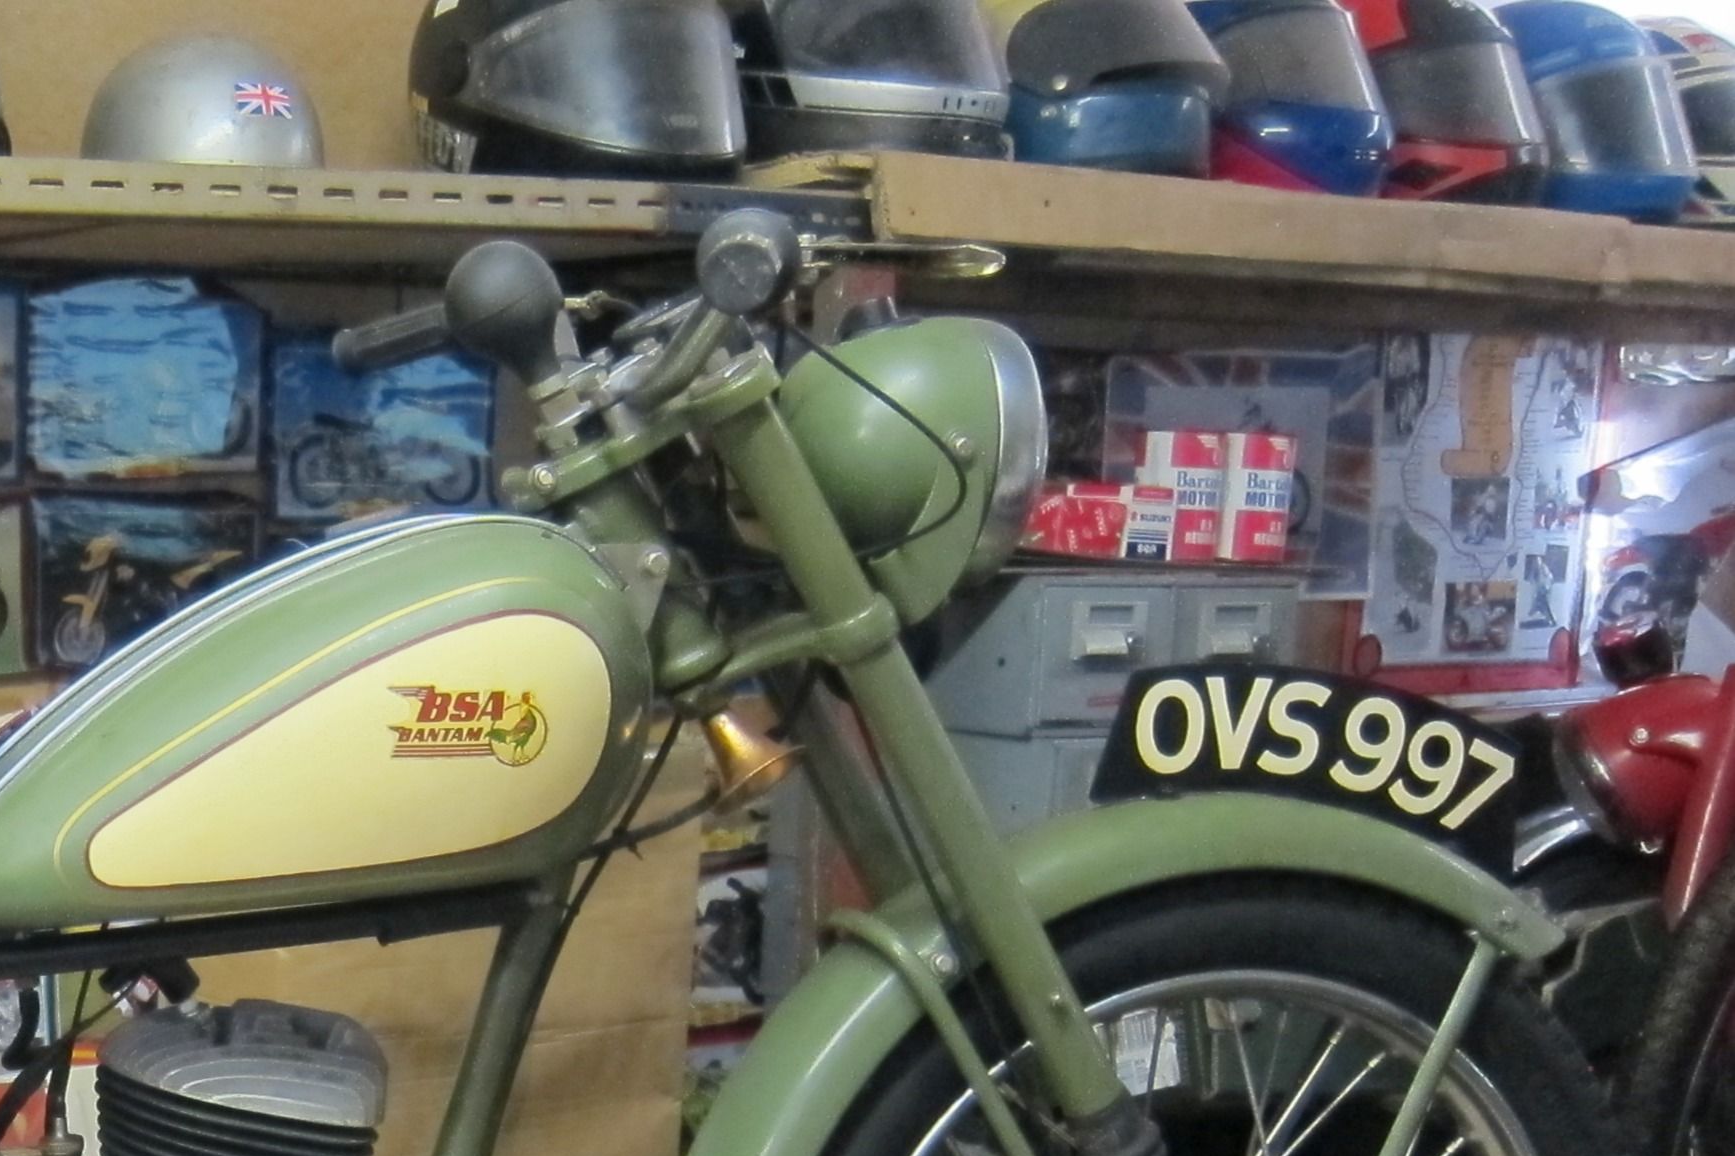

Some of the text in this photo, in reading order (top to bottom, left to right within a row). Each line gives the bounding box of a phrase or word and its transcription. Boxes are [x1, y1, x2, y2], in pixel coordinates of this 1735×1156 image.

[415, 685, 506, 723] BSA
[396, 726, 484, 743] BANTAM
[1135, 676, 1516, 830] OVS 997
